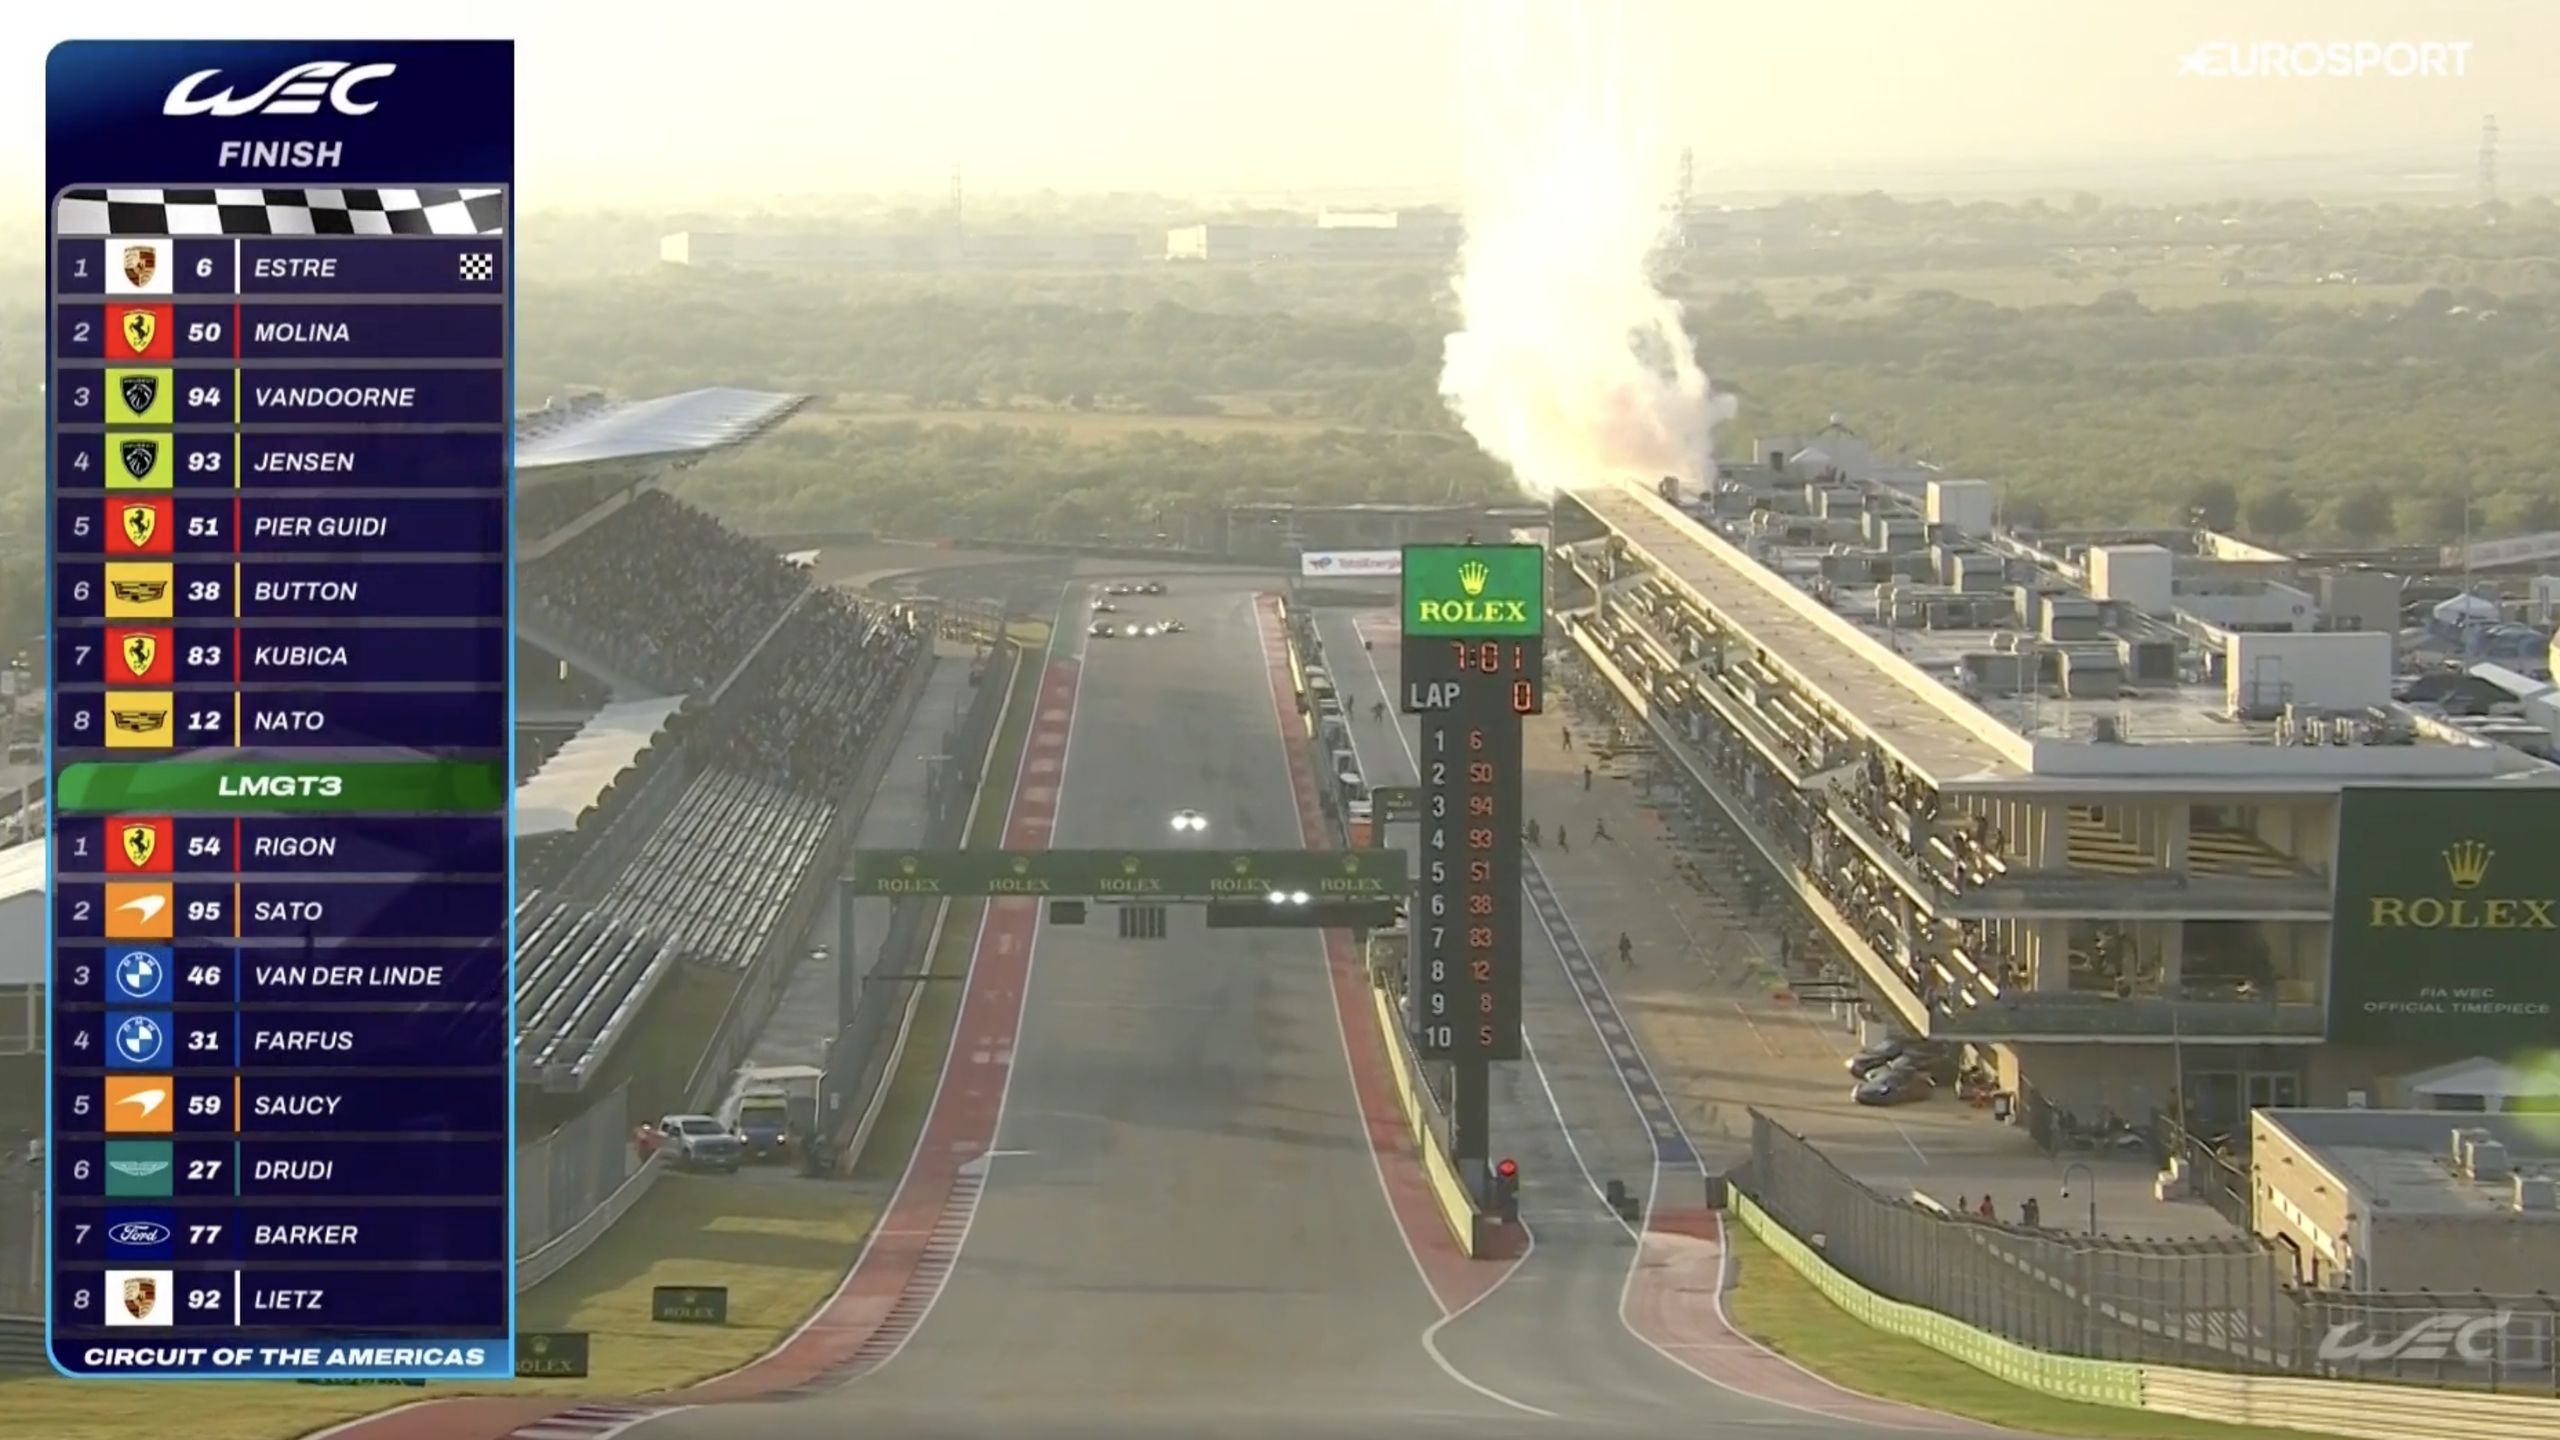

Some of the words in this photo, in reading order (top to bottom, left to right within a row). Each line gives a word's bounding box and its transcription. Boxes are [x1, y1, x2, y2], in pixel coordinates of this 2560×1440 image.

[1419, 600, 1526, 622] ROLEX
[1411, 682, 1460, 708] LAP
[1513, 681, 1531, 711] 0
[1436, 730, 1444, 750] 1
[1433, 763, 1445, 783] 2
[1432, 796, 1445, 816] 3
[1432, 829, 1445, 849] 4
[1432, 862, 1445, 882] 5
[878, 878, 940, 892] ROLEX
[989, 878, 1050, 892] ROLEX
[1100, 878, 1161, 892] ROLEX
[1210, 878, 1271, 892] ROLEX
[1321, 878, 1382, 892] ROLEX
[1431, 894, 1445, 914] 6
[2369, 897, 2558, 929] ROLEX
[1431, 927, 1444, 947] 7
[1431, 960, 1444, 980] 8
[2420, 987, 2448, 998] FIA
[2453, 987, 2495, 998] WEC
[1432, 993, 1444, 1013] 9
[2363, 1001, 2446, 1013] OFFICIAL
[2452, 1002, 2550, 1015] TIMEPIECE
[1426, 1026, 1451, 1046] 10
